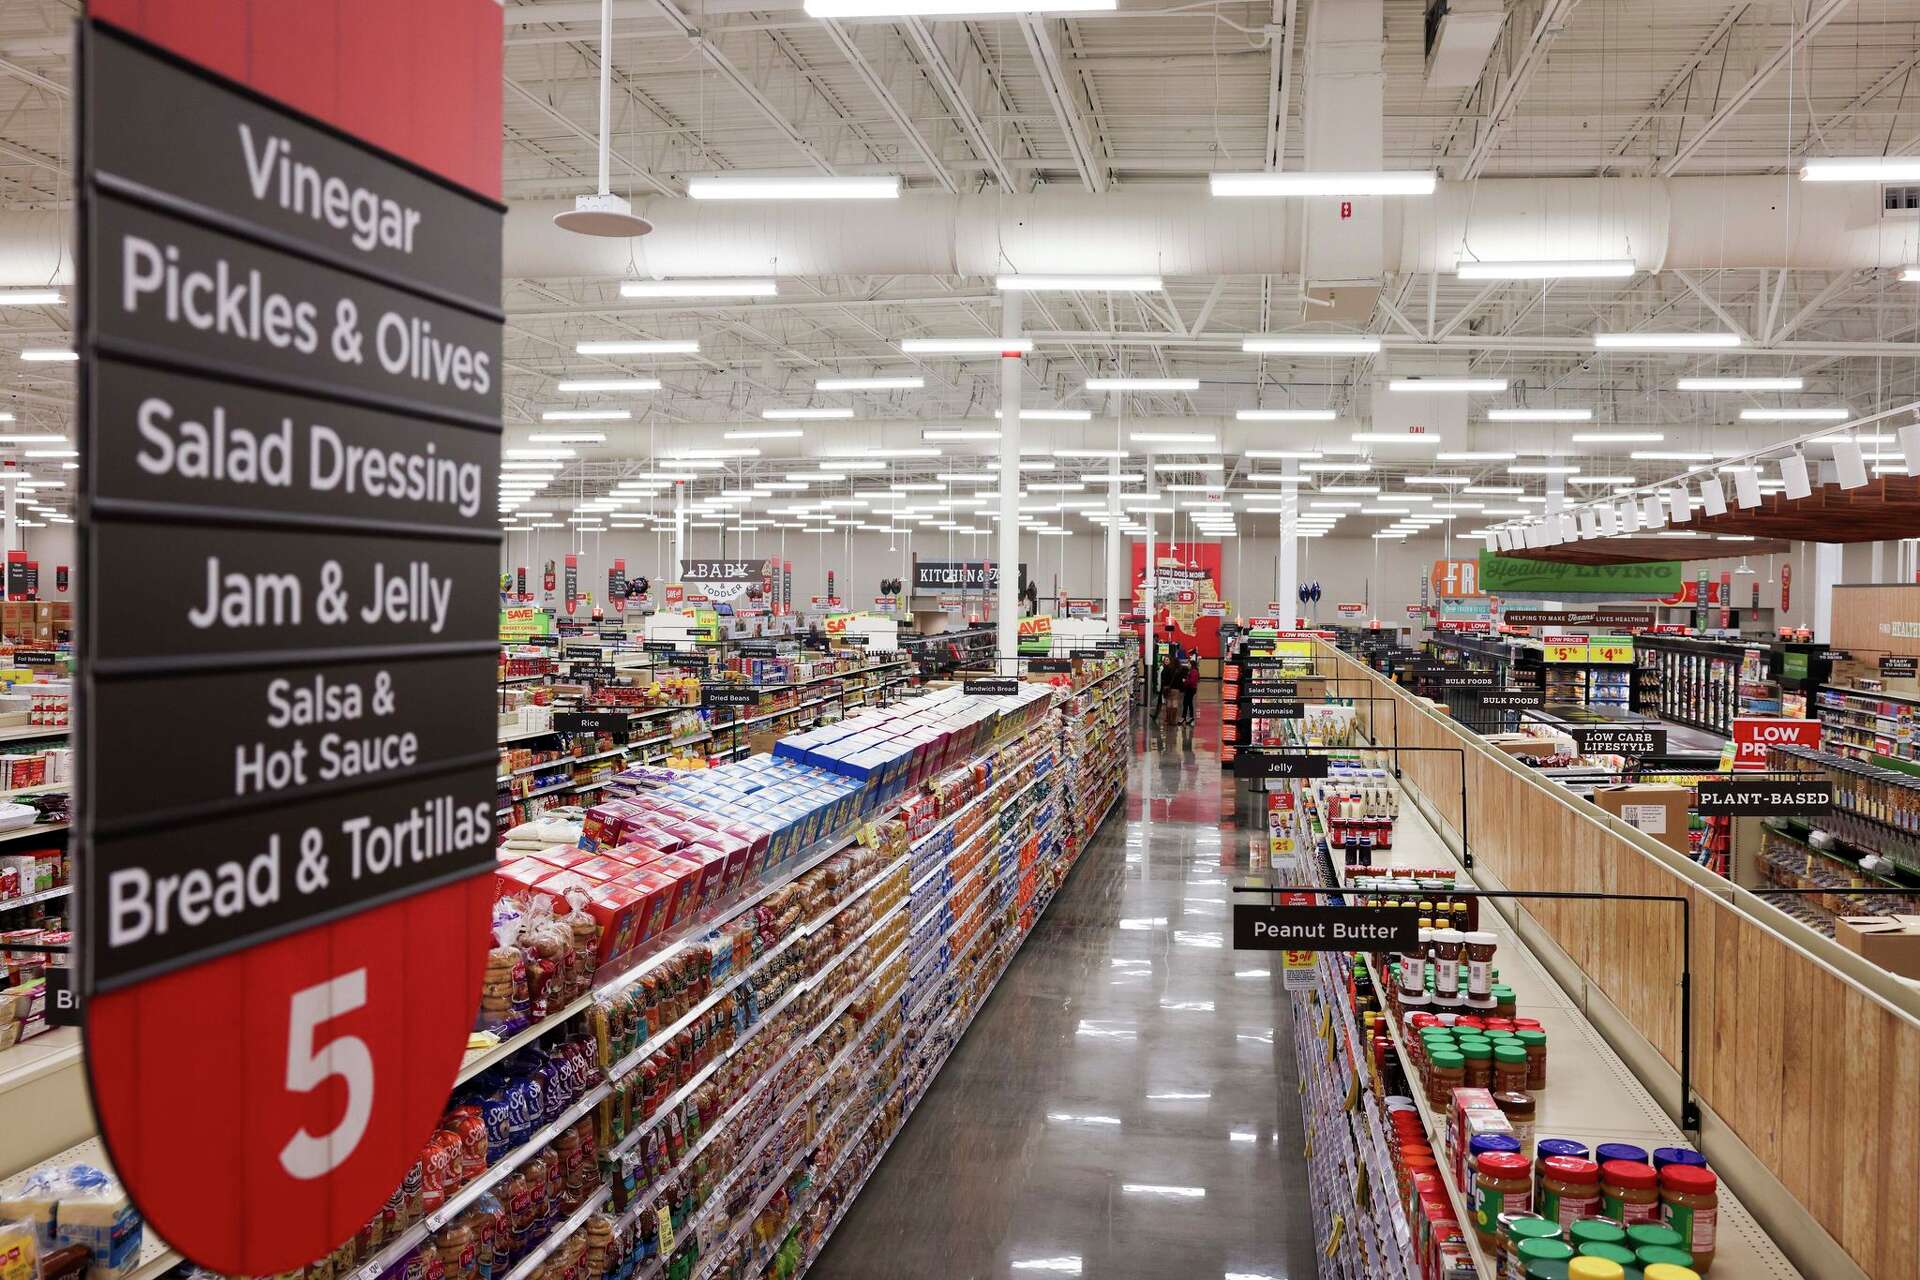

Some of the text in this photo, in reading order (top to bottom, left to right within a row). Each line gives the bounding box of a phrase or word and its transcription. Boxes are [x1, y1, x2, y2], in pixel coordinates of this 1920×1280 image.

[239, 123, 420, 253] Vinegar
[123, 235, 490, 394] Pickles & Olives
[137, 398, 480, 517] Salad Dressing
[697, 564, 748, 578] BABY
[977, 570, 984, 582] &
[1575, 565, 1673, 578] LIVING
[188, 556, 452, 633] Jam & Jelly
[703, 584, 742, 598] TODDLER
[507, 609, 533, 620] SAVE!
[1019, 618, 1052, 634] AVE!
[267, 671, 394, 729] Salsa &
[1252, 706, 1294, 715] Mayonnaise
[1586, 733, 1652, 742] LOW CARB
[1753, 726, 1800, 742] LOW
[1584, 742, 1655, 752] LIFESTYLE
[235, 731, 418, 795] Hot Sauce
[1268, 763, 1293, 774] Jelly
[1701, 793, 1830, 806] PLANT-BASED
[109, 796, 491, 948] Bread & Tortillas
[1254, 922, 1398, 940] Peanut Butter
[279, 967, 375, 1180] 5
